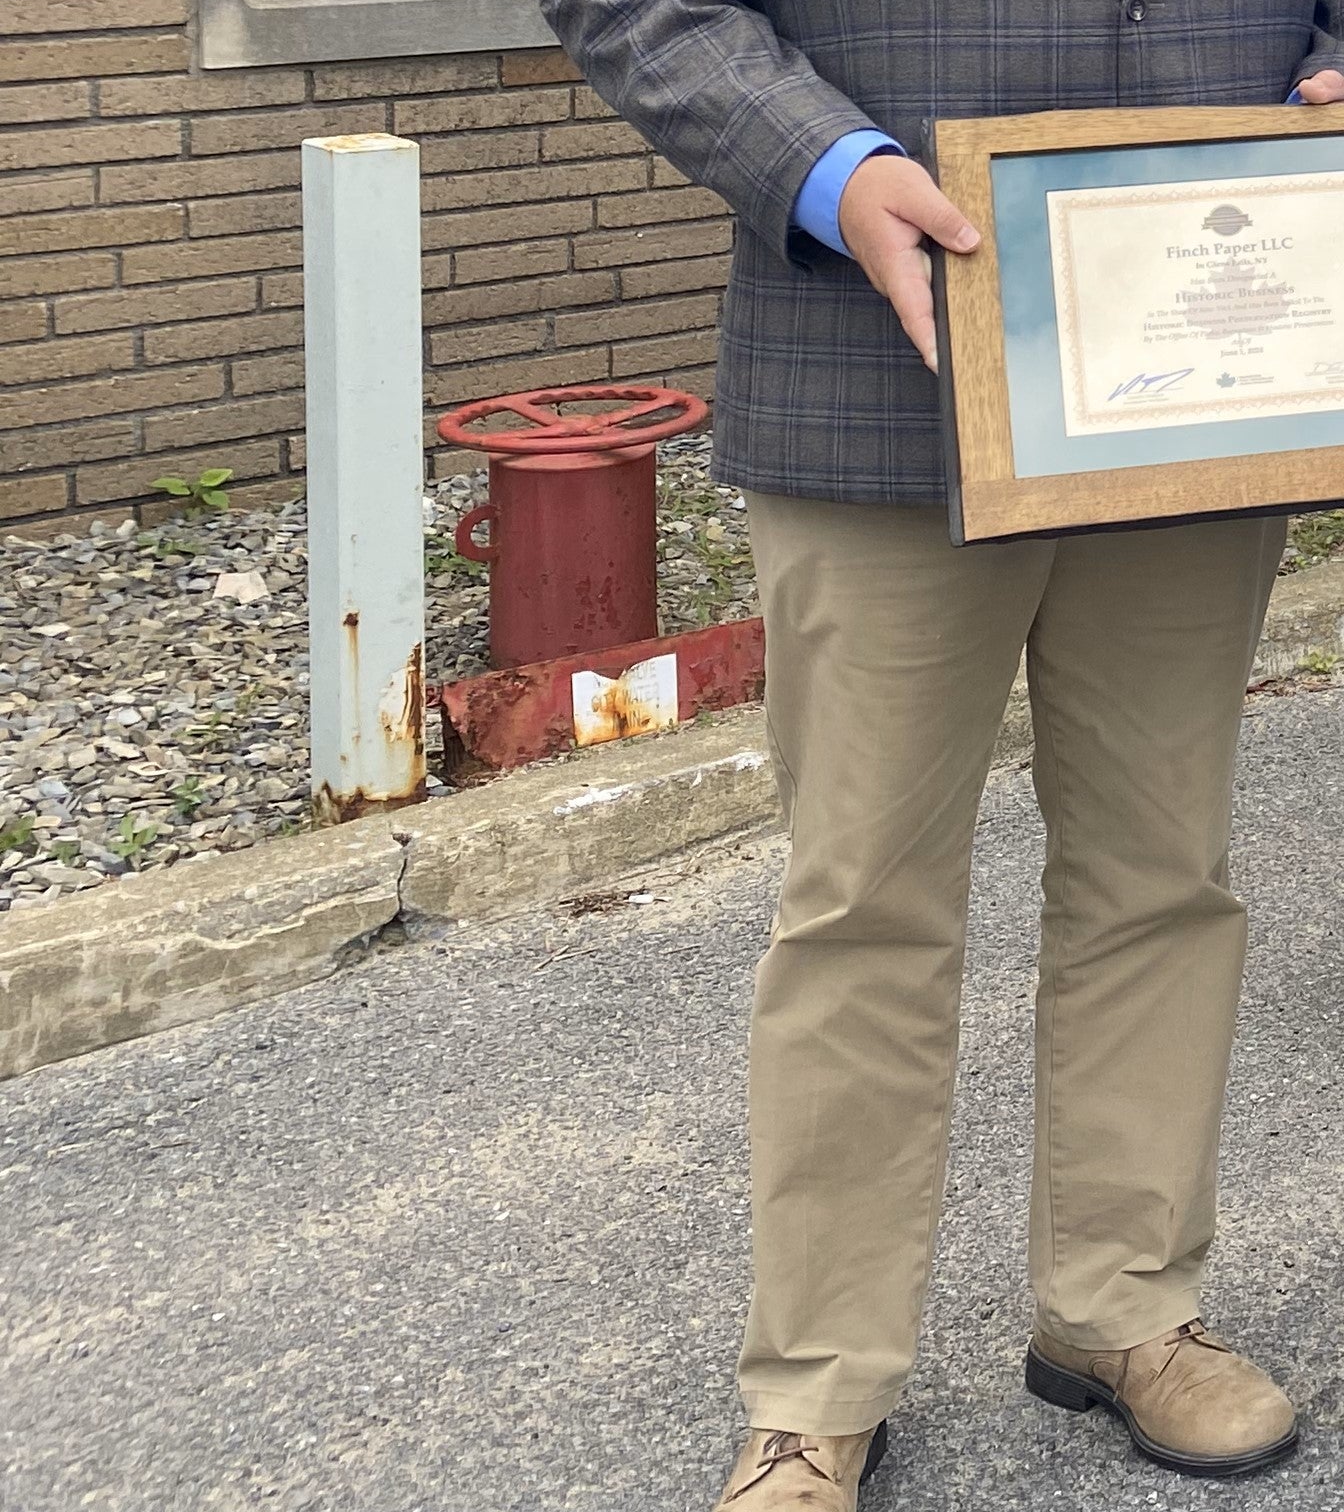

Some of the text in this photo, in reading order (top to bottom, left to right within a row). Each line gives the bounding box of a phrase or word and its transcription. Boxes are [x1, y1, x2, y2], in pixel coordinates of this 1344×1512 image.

[1166, 237, 1294, 259] Finch Paper LLC
[1196, 262, 1205, 270] In
